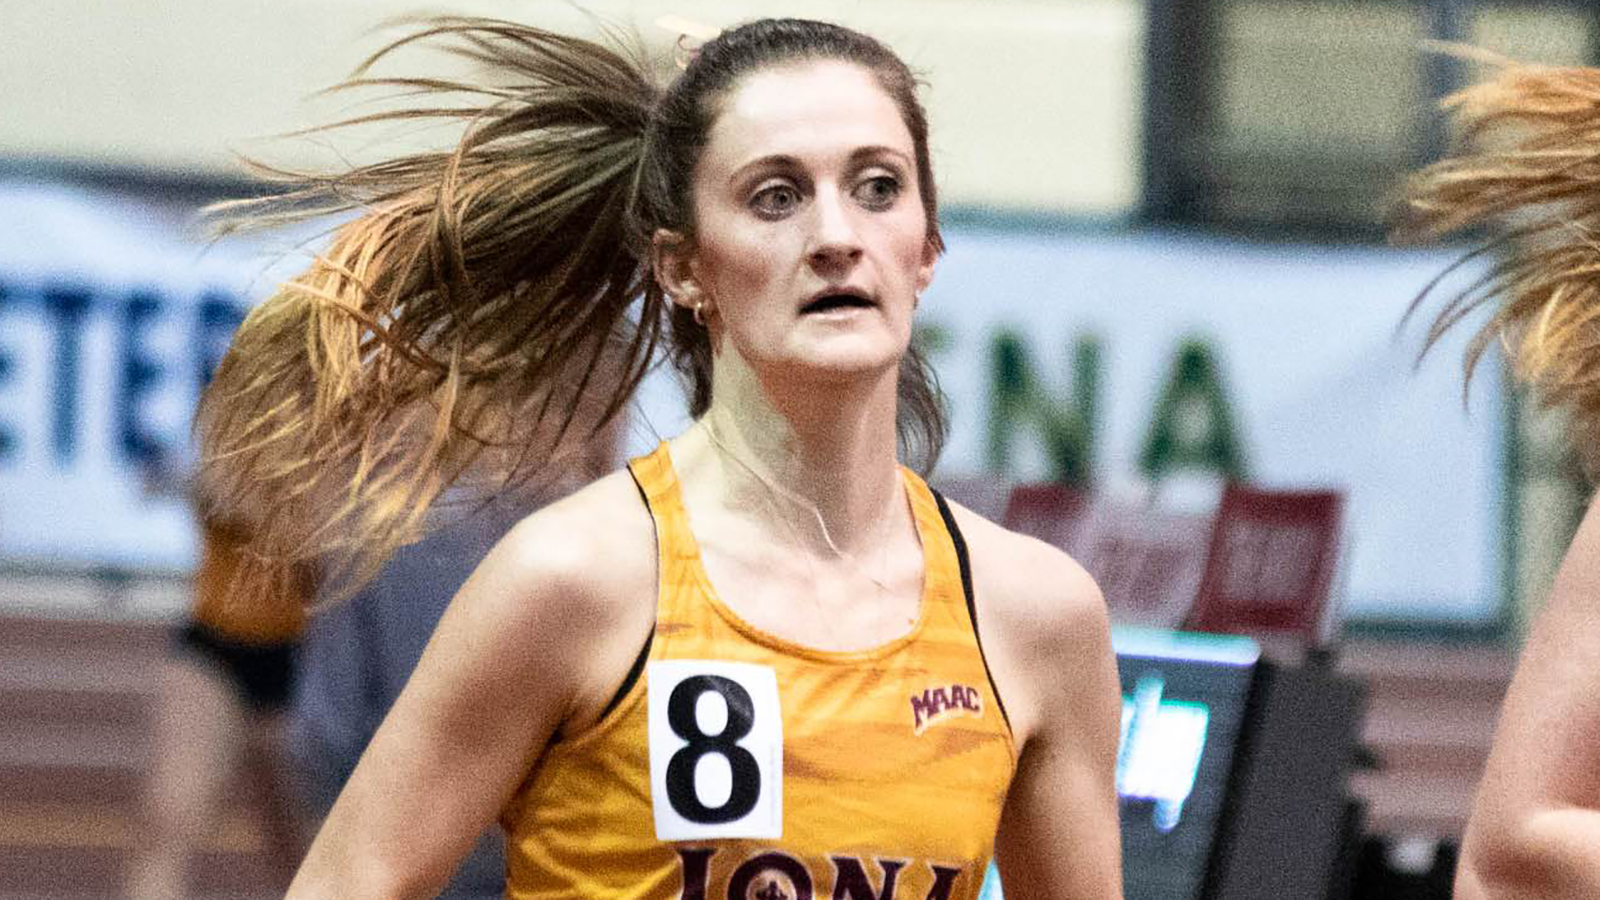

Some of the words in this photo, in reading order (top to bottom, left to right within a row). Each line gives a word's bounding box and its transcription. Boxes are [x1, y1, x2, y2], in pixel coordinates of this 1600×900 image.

[914, 322, 1248, 486] NA
[666, 674, 761, 825] 8
[910, 683, 981, 730] MAAC
